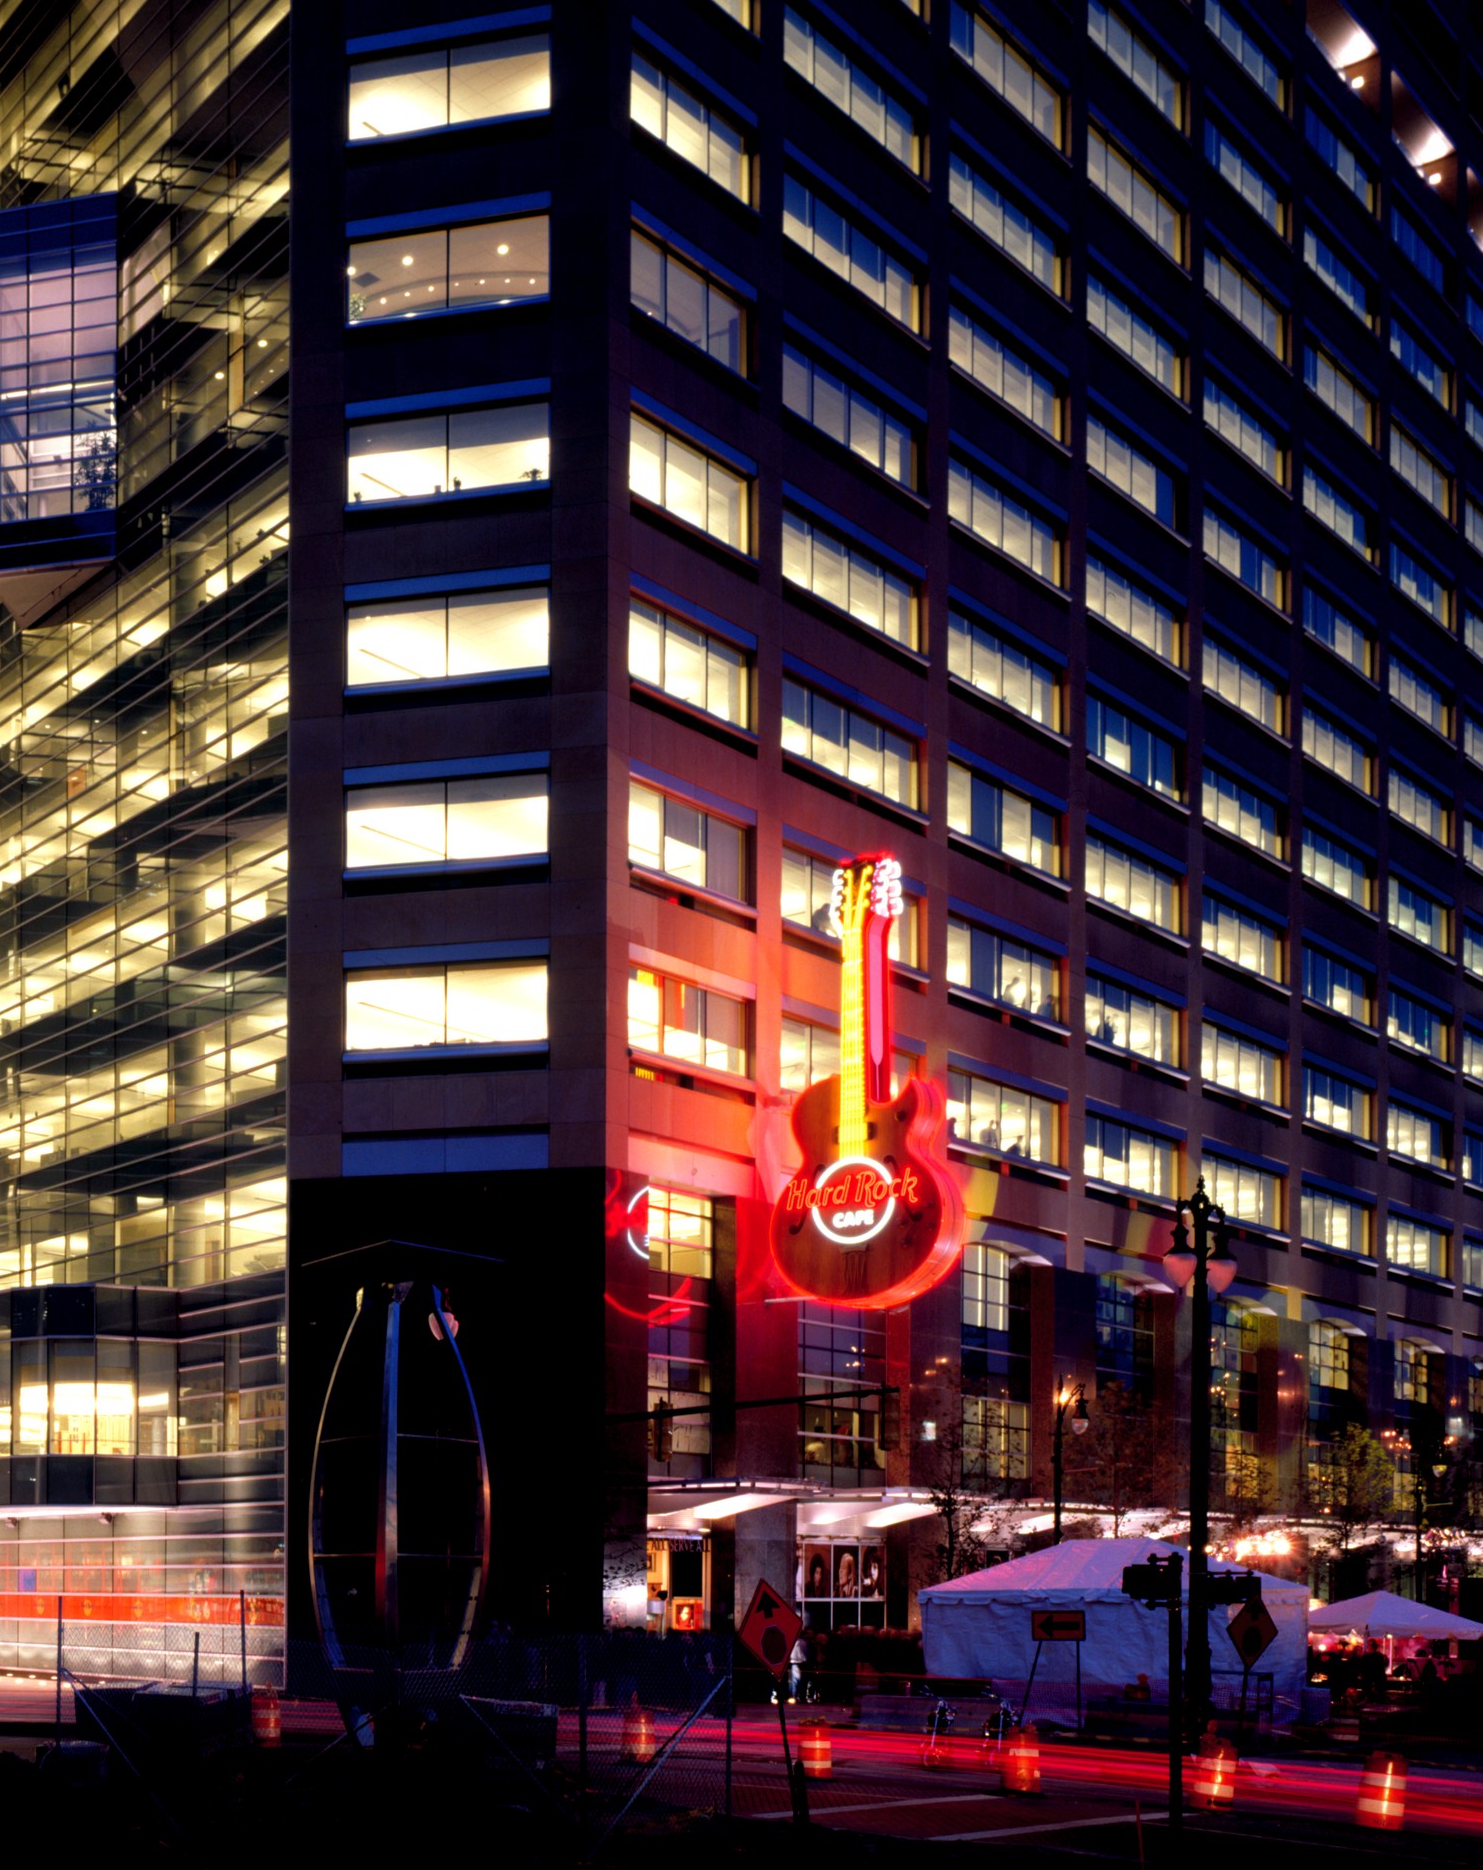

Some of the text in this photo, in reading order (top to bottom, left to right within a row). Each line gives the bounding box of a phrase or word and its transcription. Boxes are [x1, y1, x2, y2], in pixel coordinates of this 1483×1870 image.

[786, 1167, 919, 1211] Hard Rock
[832, 1209, 875, 1229] CAFE
